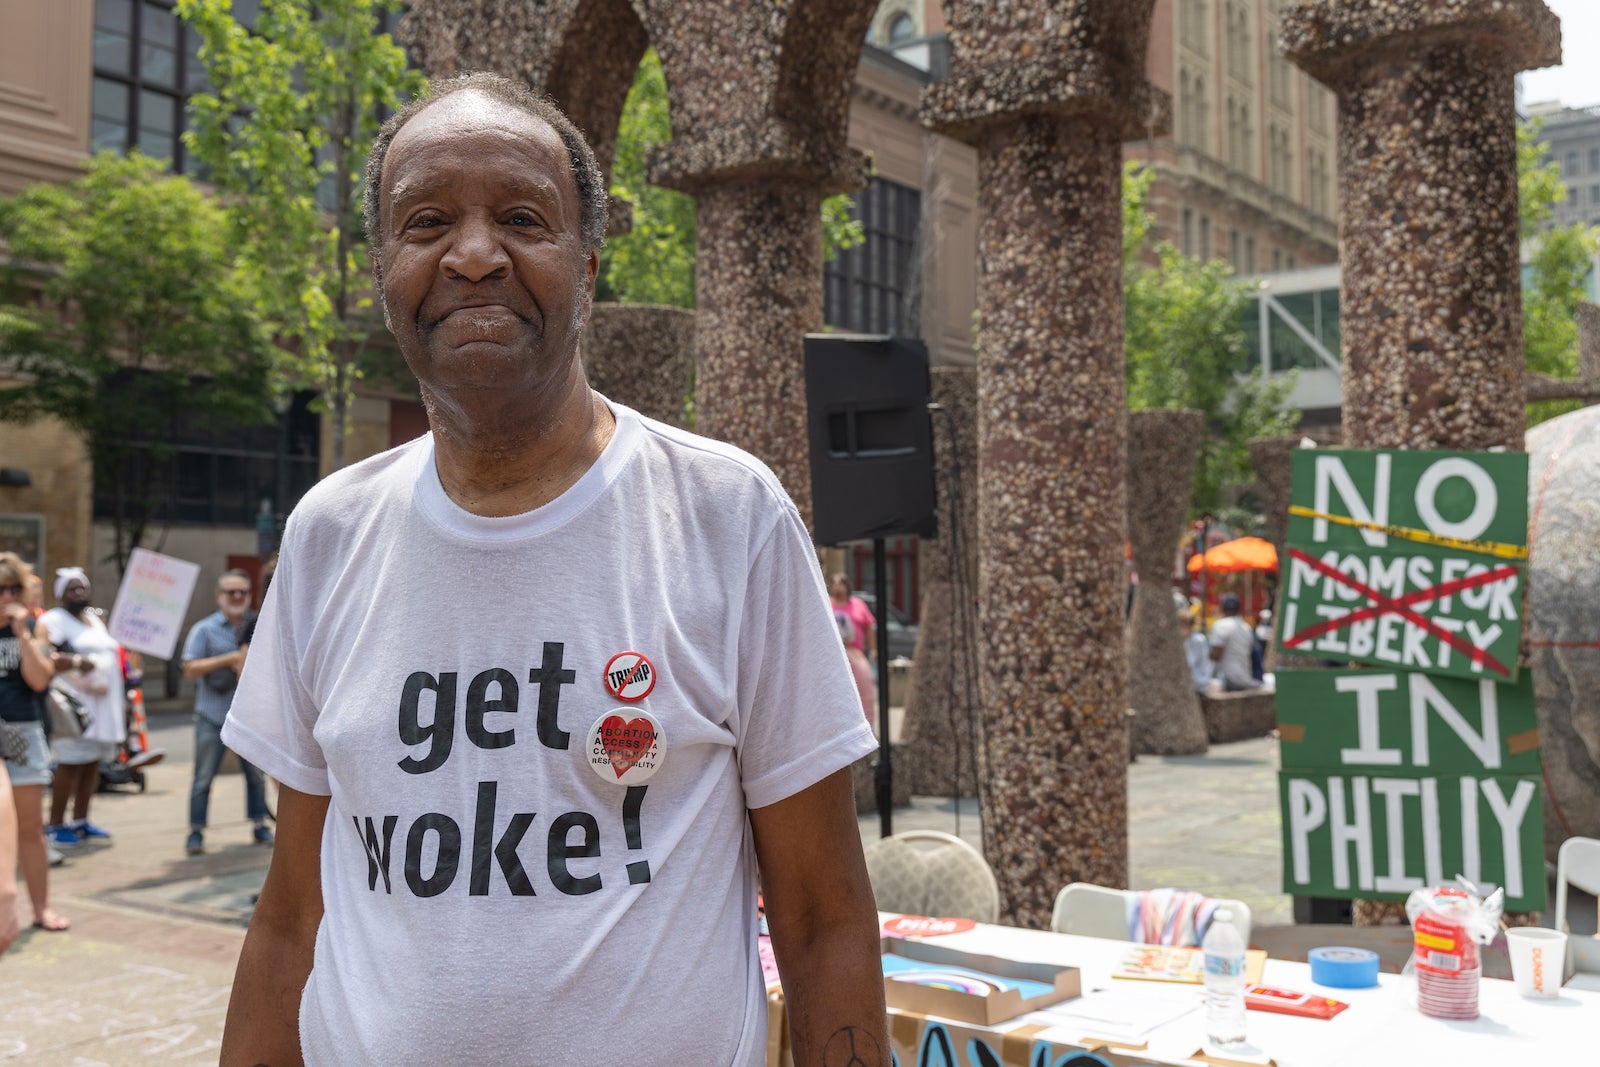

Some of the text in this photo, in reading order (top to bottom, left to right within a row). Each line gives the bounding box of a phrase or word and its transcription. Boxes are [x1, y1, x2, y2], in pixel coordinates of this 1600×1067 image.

[1313, 453, 1498, 548] NO
[1288, 550, 1519, 621] MOMS FOR
[609, 664, 650, 688] TRUMP
[1281, 602, 1503, 674] LIBERTY
[397, 641, 577, 775] get
[594, 737, 640, 749] ACCESS
[597, 727, 658, 740] ABORTION
[1334, 671, 1502, 770] IN
[352, 780, 652, 898] woke!
[1288, 775, 1536, 899] PHILLY
